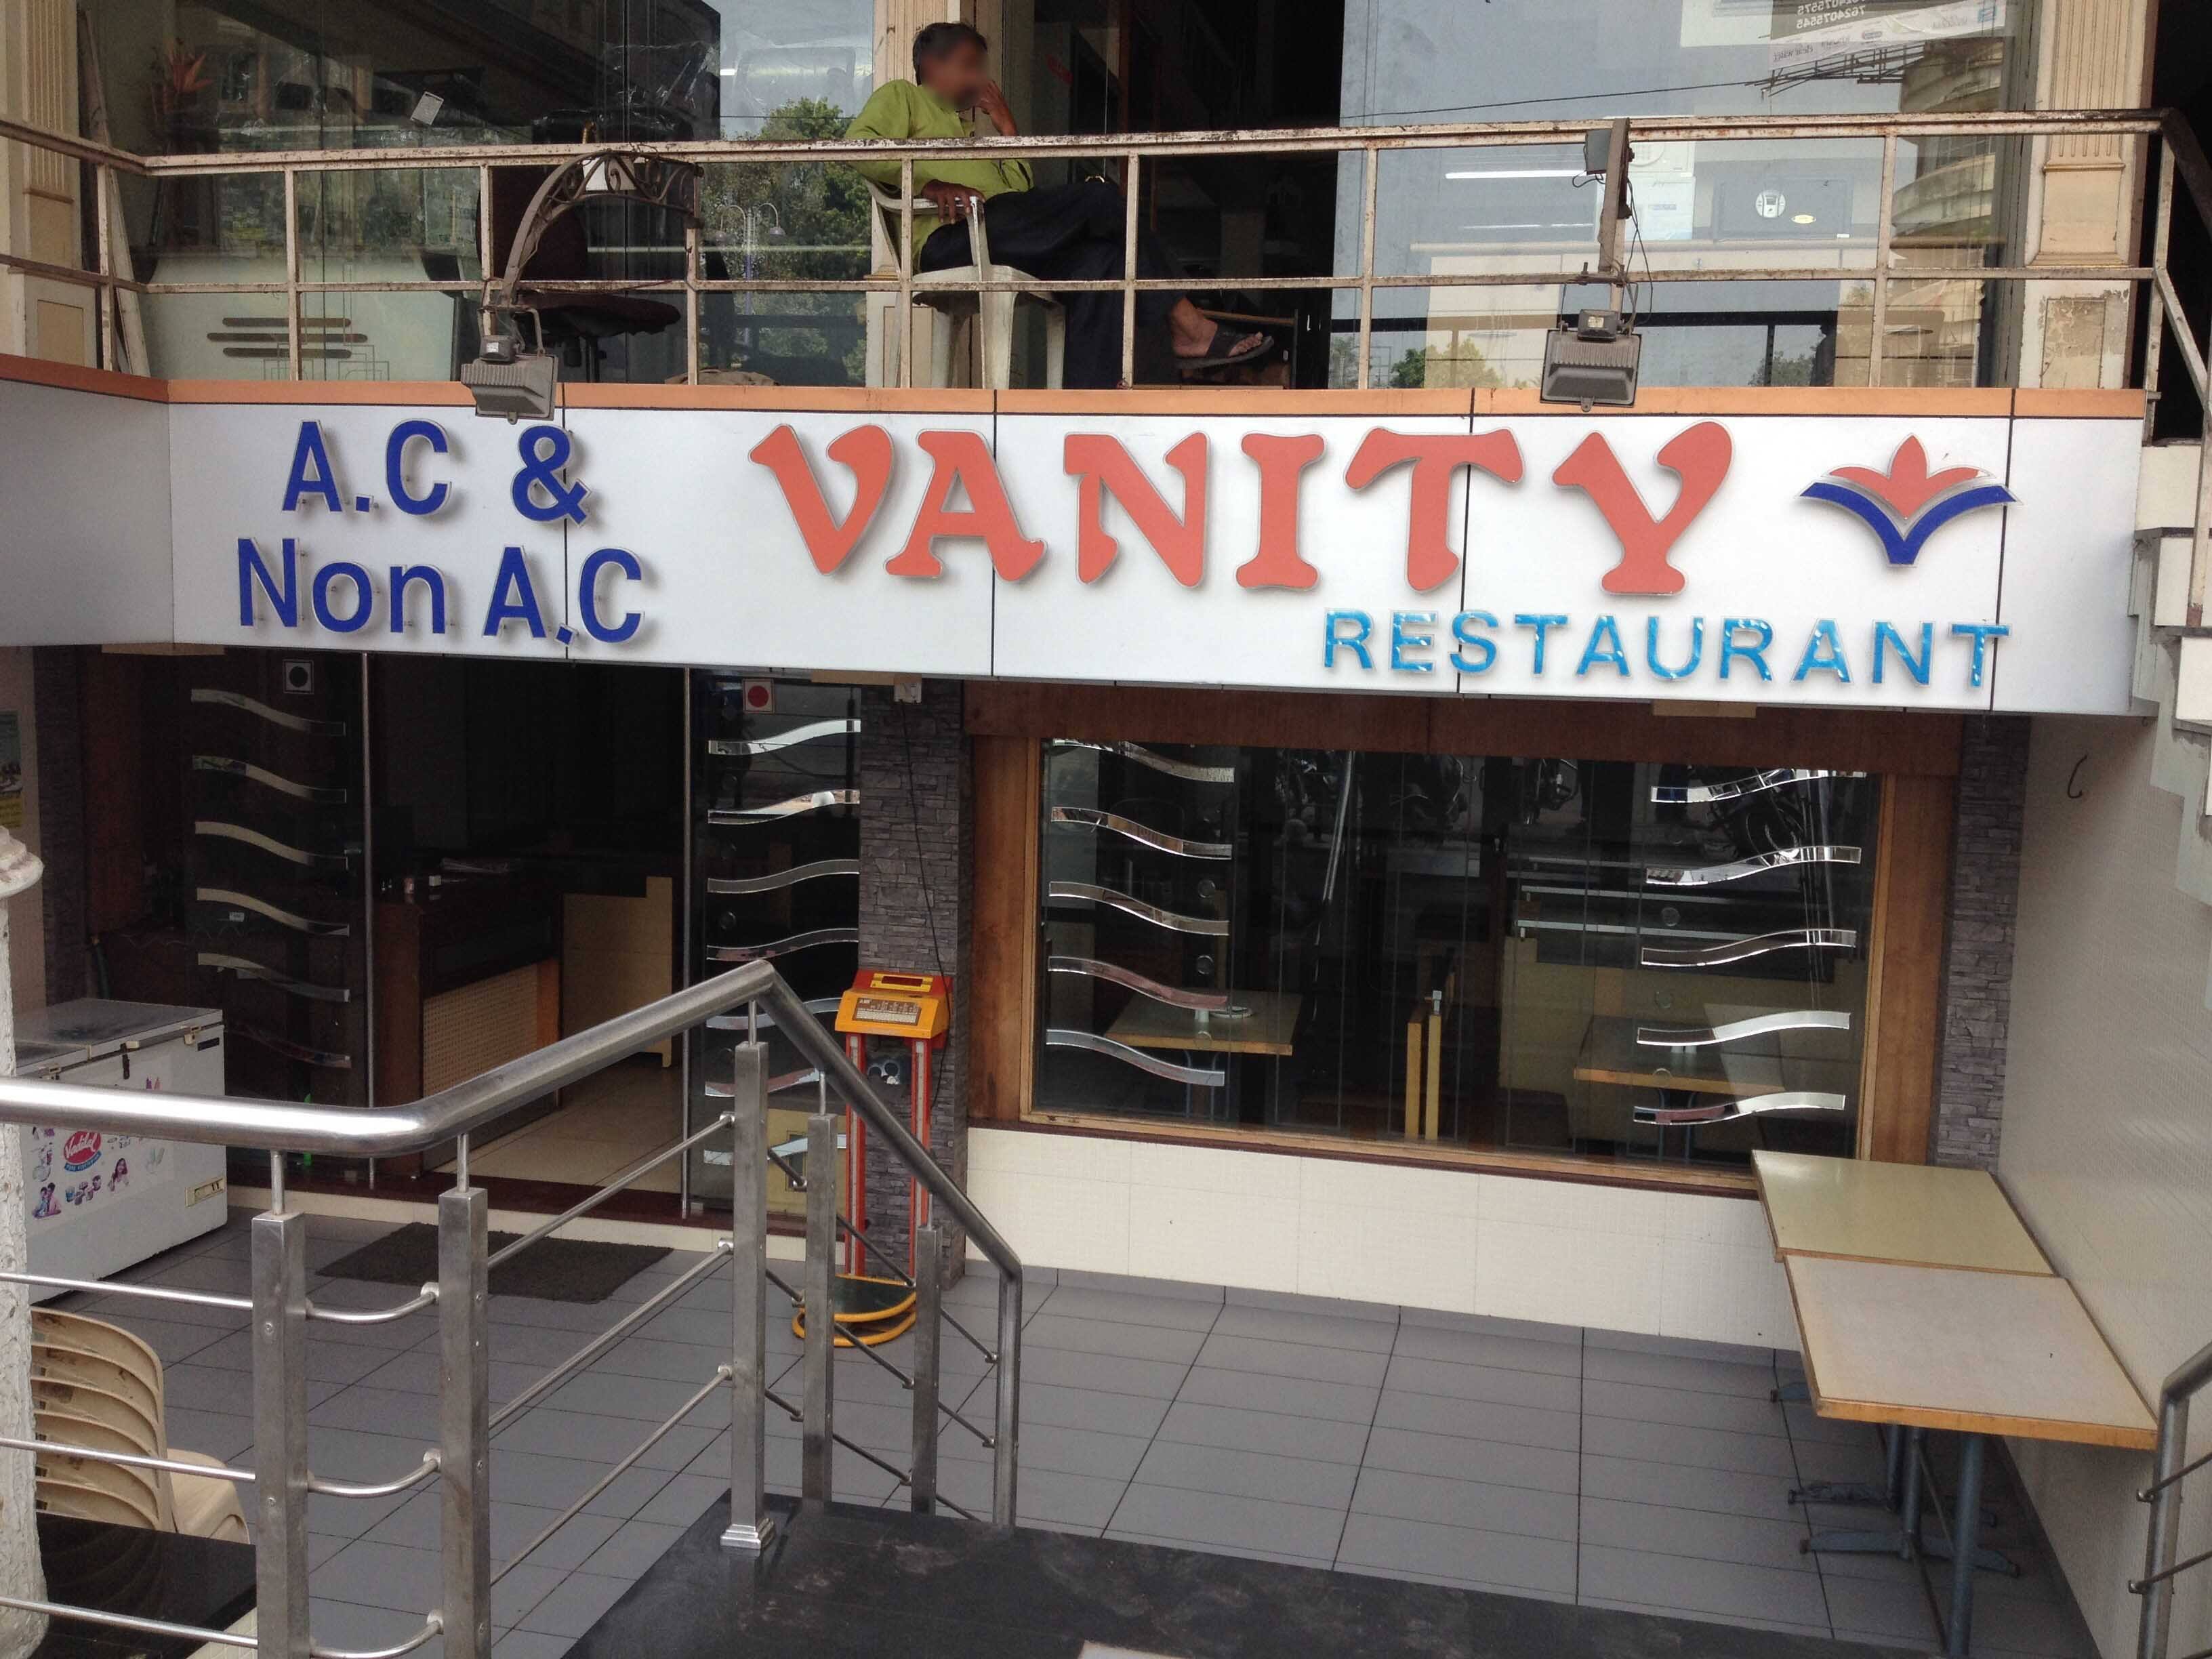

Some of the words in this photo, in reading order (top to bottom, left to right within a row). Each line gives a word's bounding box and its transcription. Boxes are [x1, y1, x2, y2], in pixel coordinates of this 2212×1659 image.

[282, 419, 452, 517] A.C
[511, 425, 590, 525] &
[748, 419, 1734, 596] VANITY
[237, 537, 447, 634] Non
[483, 546, 644, 645] A.C
[1323, 610, 2013, 689] RESTAURANT
